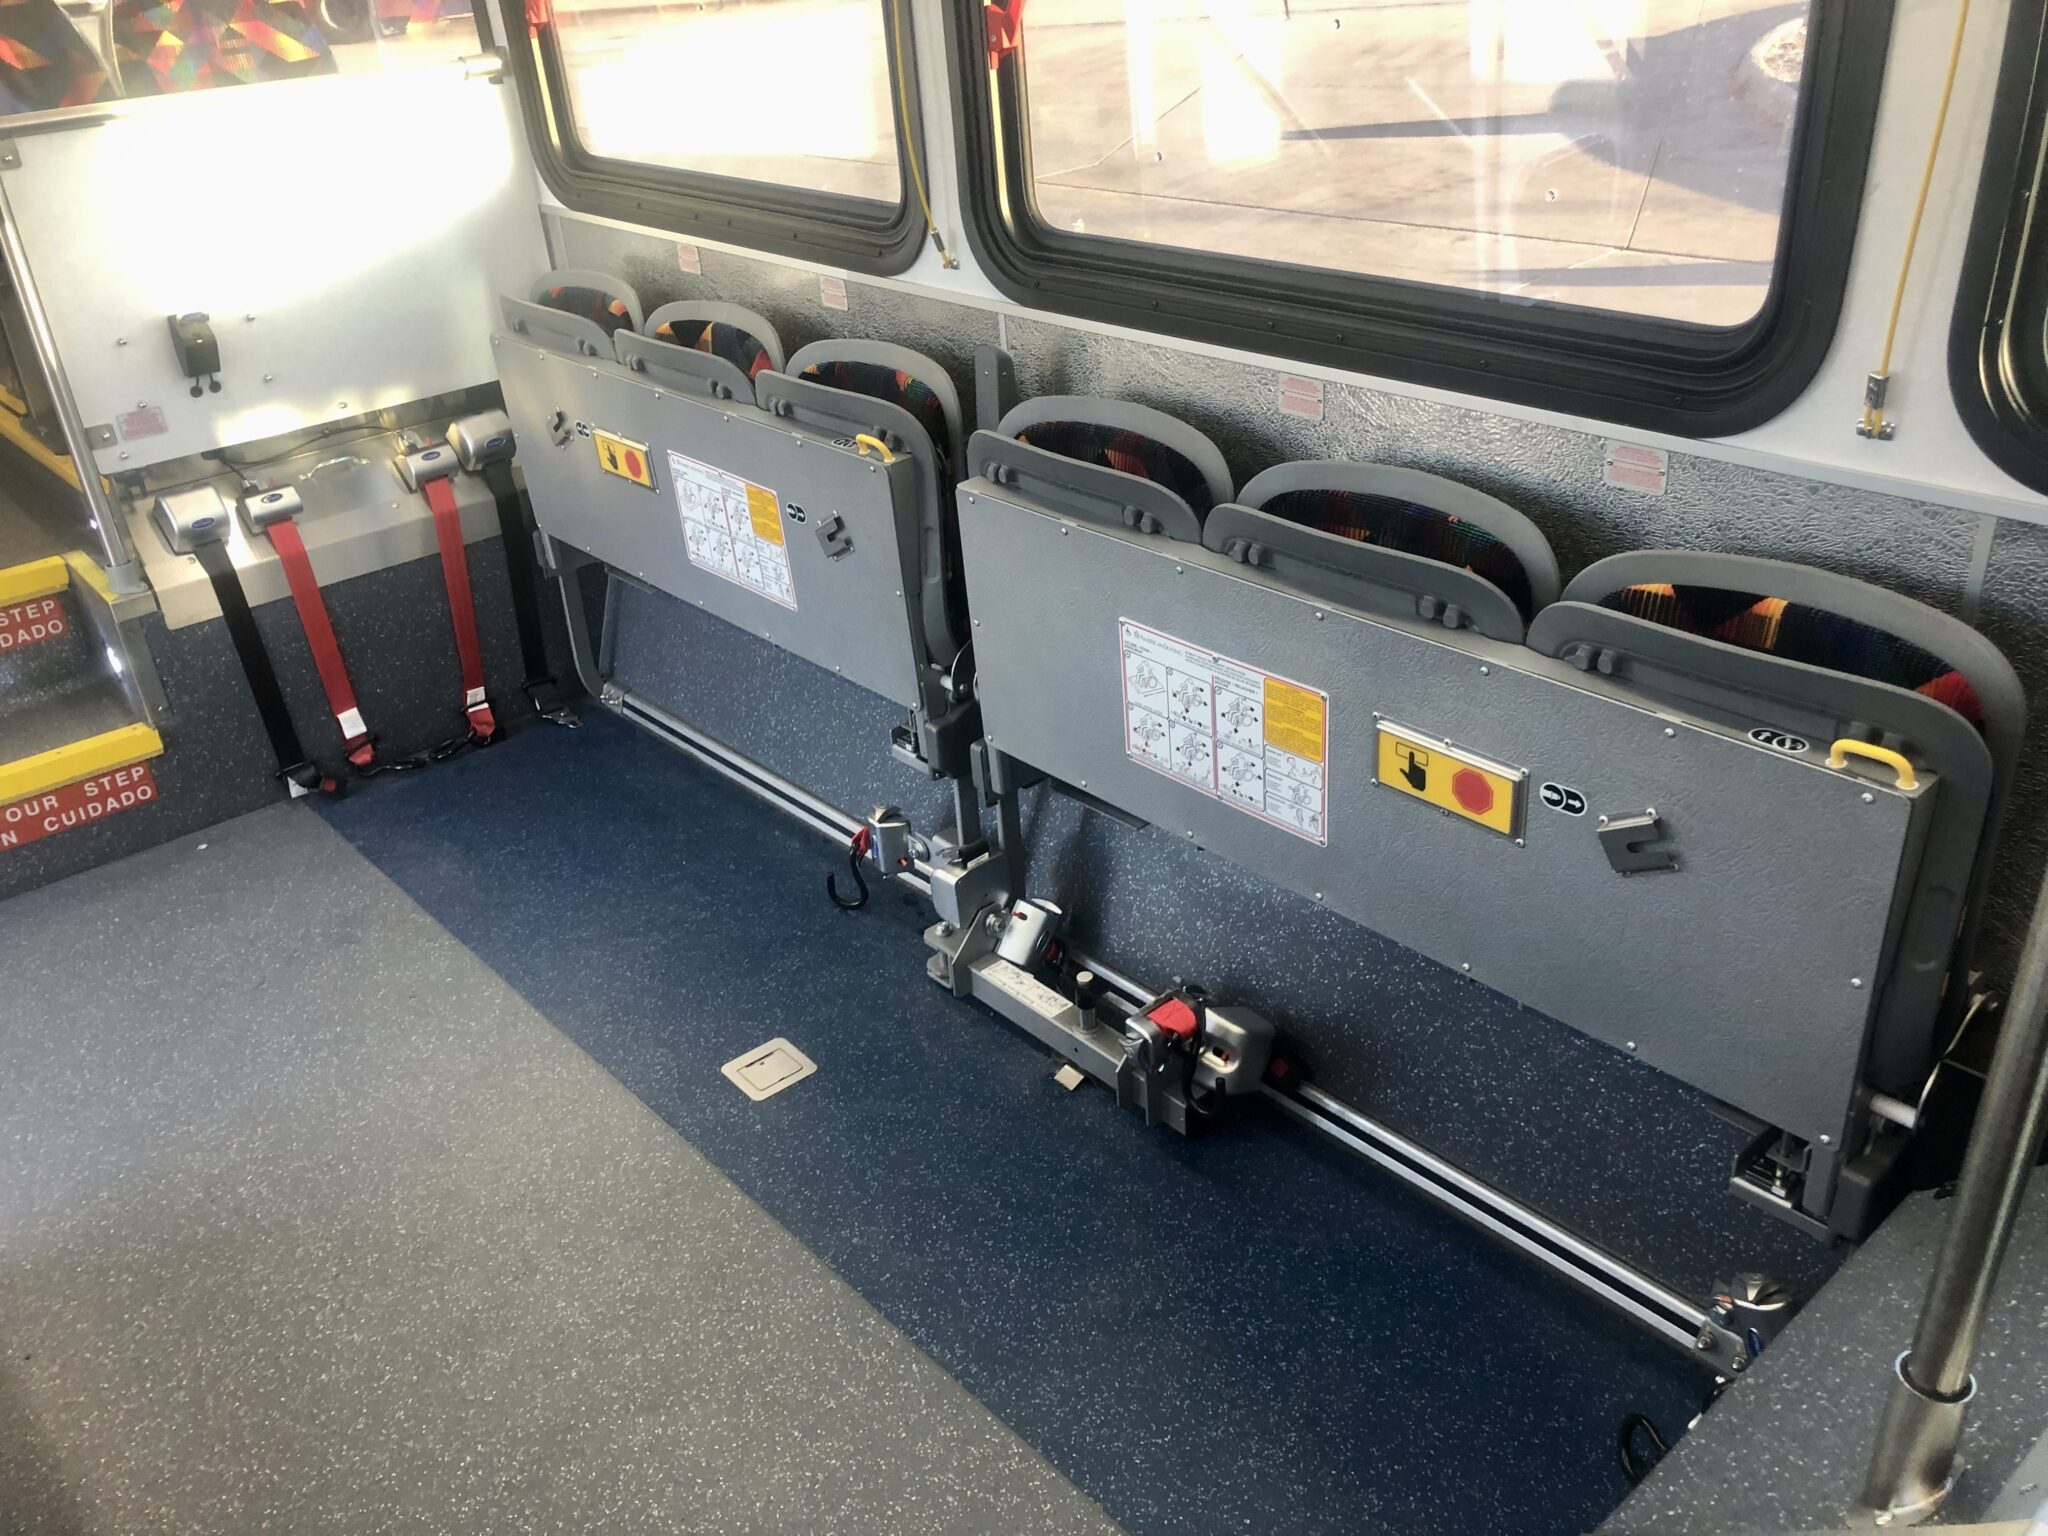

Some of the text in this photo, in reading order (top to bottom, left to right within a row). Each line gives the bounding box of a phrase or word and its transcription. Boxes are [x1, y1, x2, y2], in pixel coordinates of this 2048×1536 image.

[0, 600, 55, 627] STEP
[5, 766, 145, 822] OUR STEP
[43, 785, 152, 831] CUIDADO
